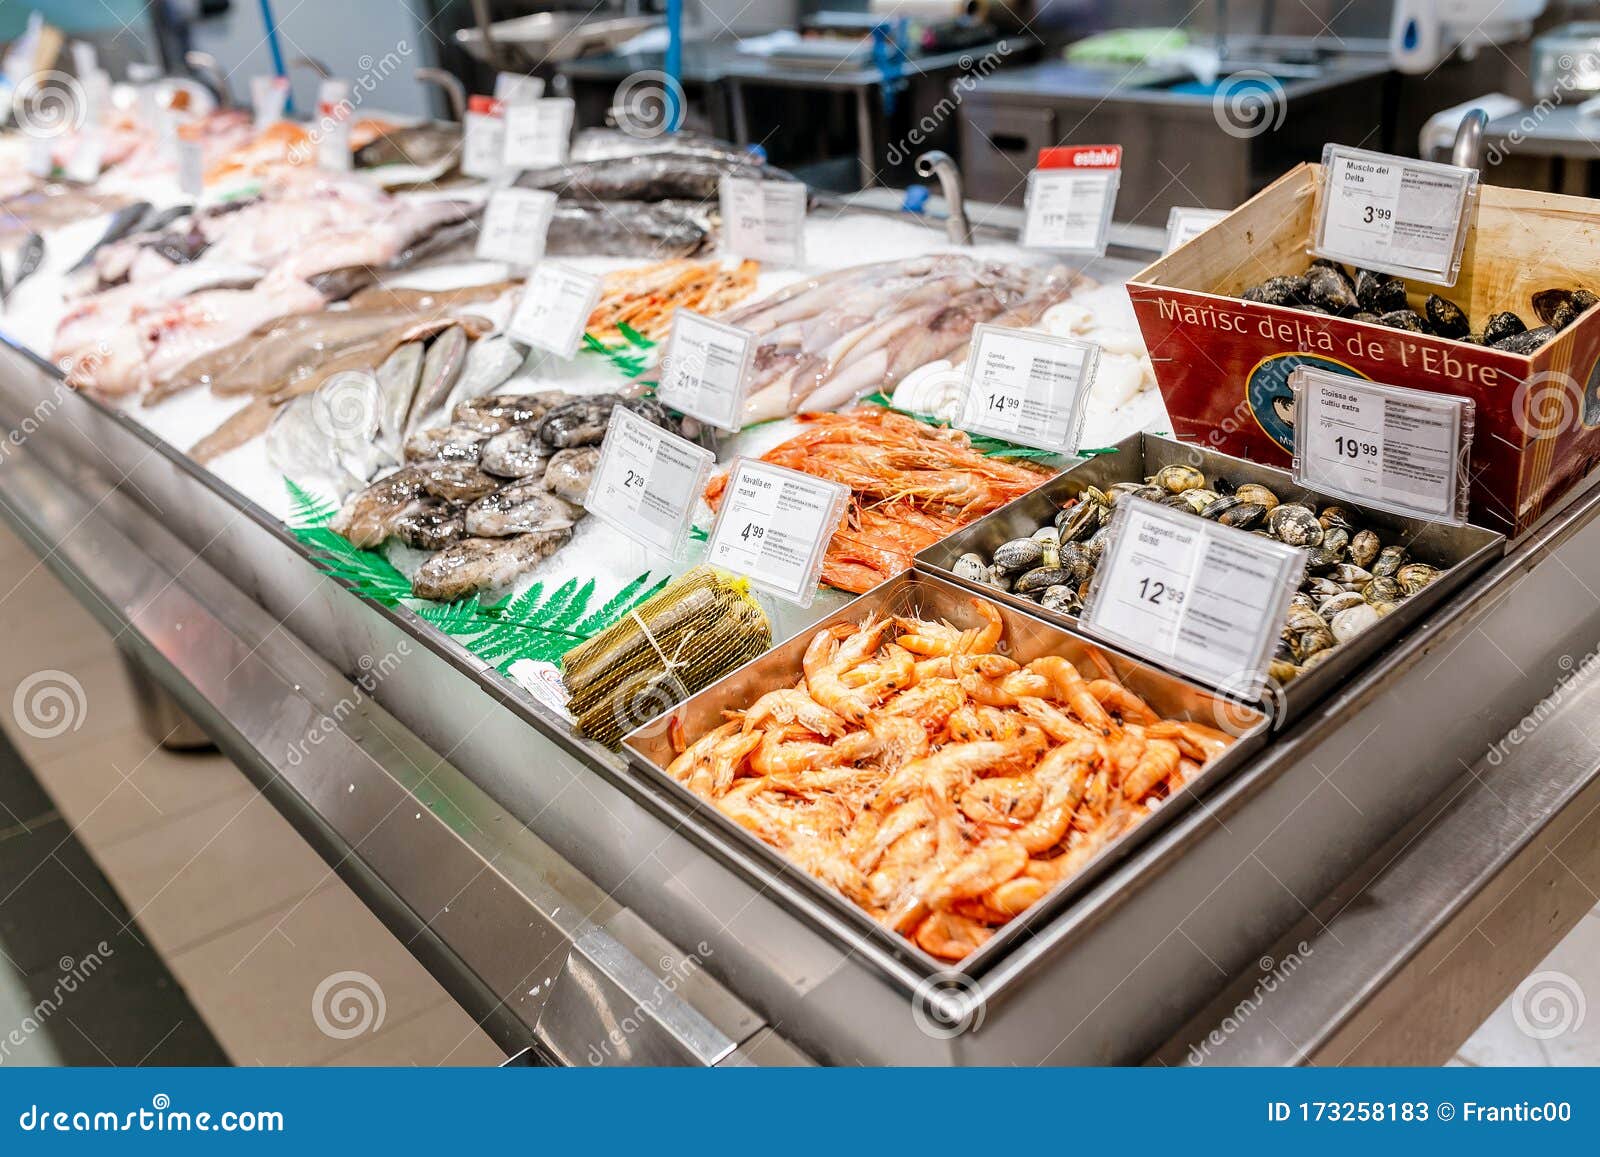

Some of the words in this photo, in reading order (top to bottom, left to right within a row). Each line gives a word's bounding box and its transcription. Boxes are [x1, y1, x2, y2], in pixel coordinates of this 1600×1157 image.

[1073, 149, 1118, 167] estalvi
[1158, 297, 1247, 335] Marisc
[1258, 315, 1334, 352] delta
[1347, 332, 1385, 361] de
[1341, 404, 1360, 413] extra
